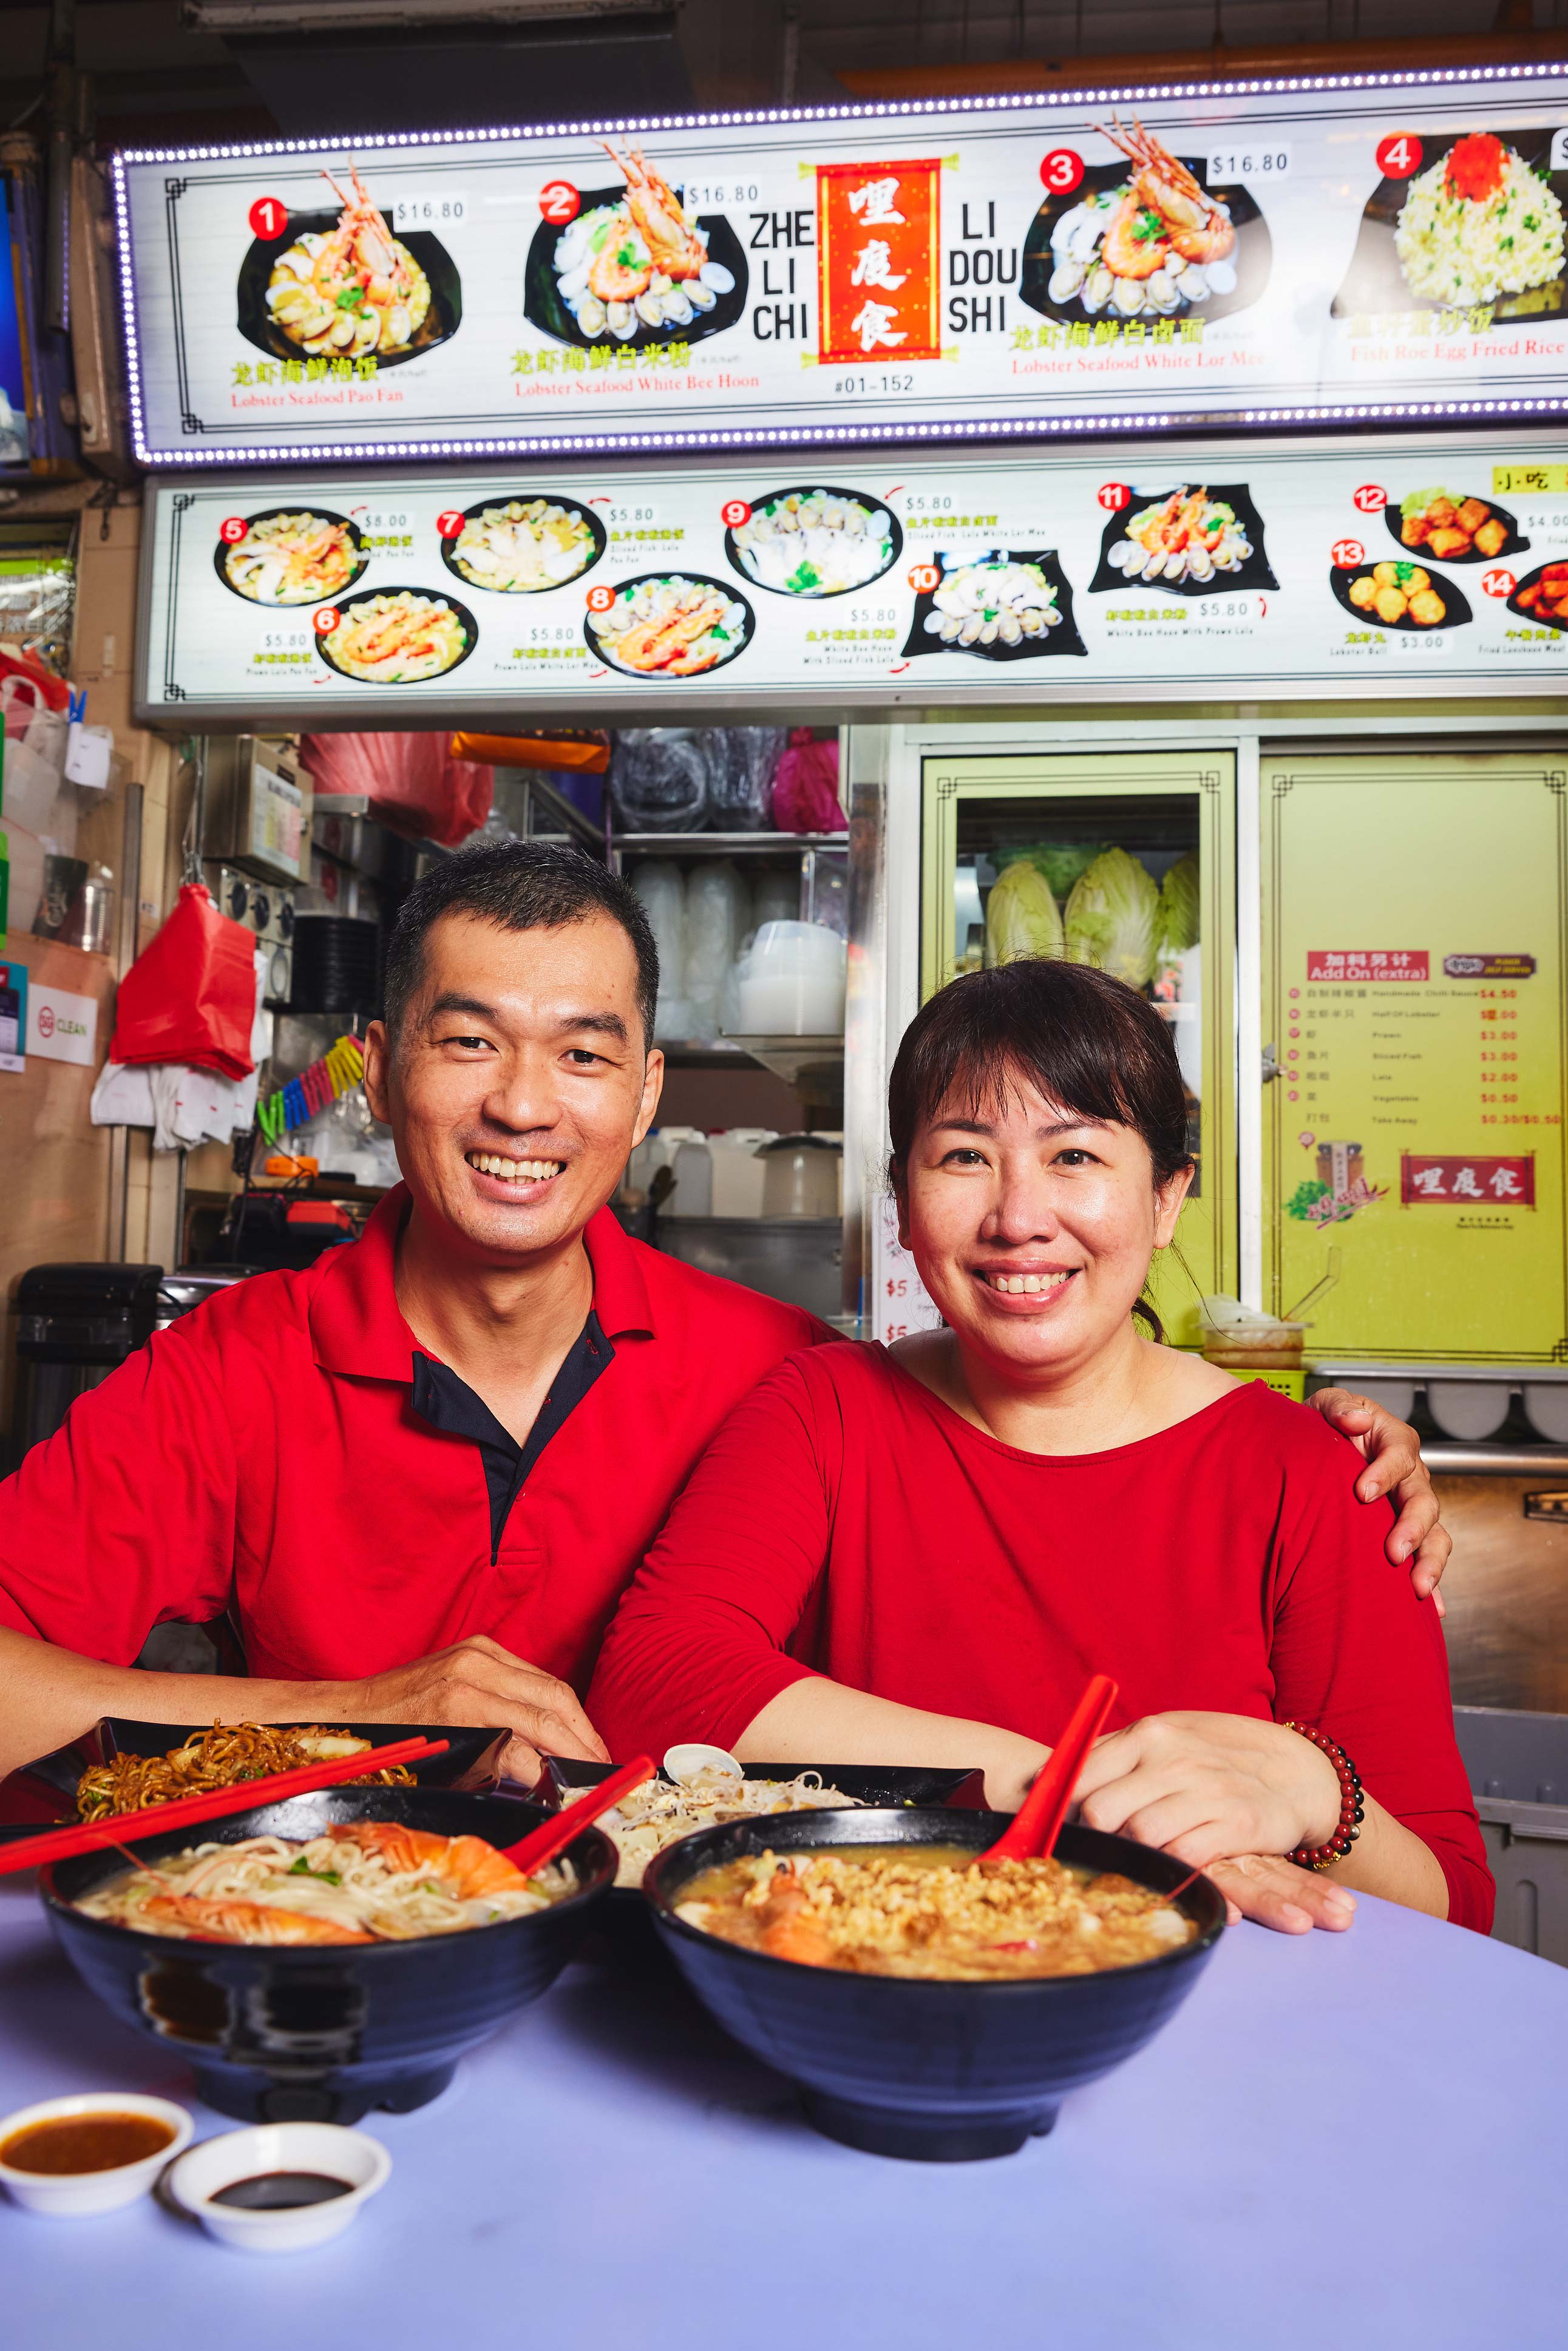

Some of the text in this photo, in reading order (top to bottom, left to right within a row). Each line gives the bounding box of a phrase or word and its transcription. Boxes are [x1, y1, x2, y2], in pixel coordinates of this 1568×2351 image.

[1212, 153, 1288, 174] $16.80
[1384, 138, 1411, 170] 4
[1049, 154, 1074, 186] 3
[548, 186, 570, 215] 2
[689, 185, 758, 205] $16.80
[258, 202, 275, 232] 1
[398, 202, 464, 220] $16.80
[962, 201, 995, 240] LI
[750, 210, 814, 249] ZHE
[764, 258, 795, 295] LI
[949, 248, 1017, 286] DOU
[753, 304, 807, 340] CHI
[948, 296, 1005, 333] SHI
[1008, 317, 1207, 351] 龙虾海鲜白卤面
[511, 341, 693, 376] 龙虾海鲜白米粉
[1434, 343, 1467, 362] Egg
[1472, 340, 1518, 356] Fried
[1525, 339, 1565, 354] Rice
[231, 355, 379, 387] 龙虾海鲜泡饭
[1012, 358, 1071, 375] Lobster
[1078, 355, 1139, 371] Seafood
[1145, 354, 1192, 369] White
[1197, 351, 1225, 368] Lor
[515, 373, 760, 397] Lobster Seafood White Bee Hoon
[835, 376, 913, 393] #01-152
[231, 388, 404, 409] Lobster Seafood Pao Fan
[907, 497, 951, 510] $5.80
[1099, 486, 1123, 507] 11
[1354, 487, 1385, 511] 12
[443, 514, 460, 533] 7
[611, 509, 653, 521] $5.80
[728, 503, 745, 524] 9
[225, 520, 243, 540] 5
[1332, 543, 1363, 566] 13
[910, 568, 938, 588] 10
[1482, 572, 1513, 595] 14
[591, 588, 609, 609] 8
[316, 610, 334, 630] 6
[852, 609, 895, 622] $5.80
[1201, 603, 1248, 617] $5.80
[531, 628, 574, 640] $5.80
[1402, 636, 1444, 648] $3.00
[1325, 952, 1413, 968] 加料另计
[1310, 966, 1427, 981] Add On (extra)
[58, 1019, 87, 1036] CLEAN
[886, 1277, 908, 1298] $5
